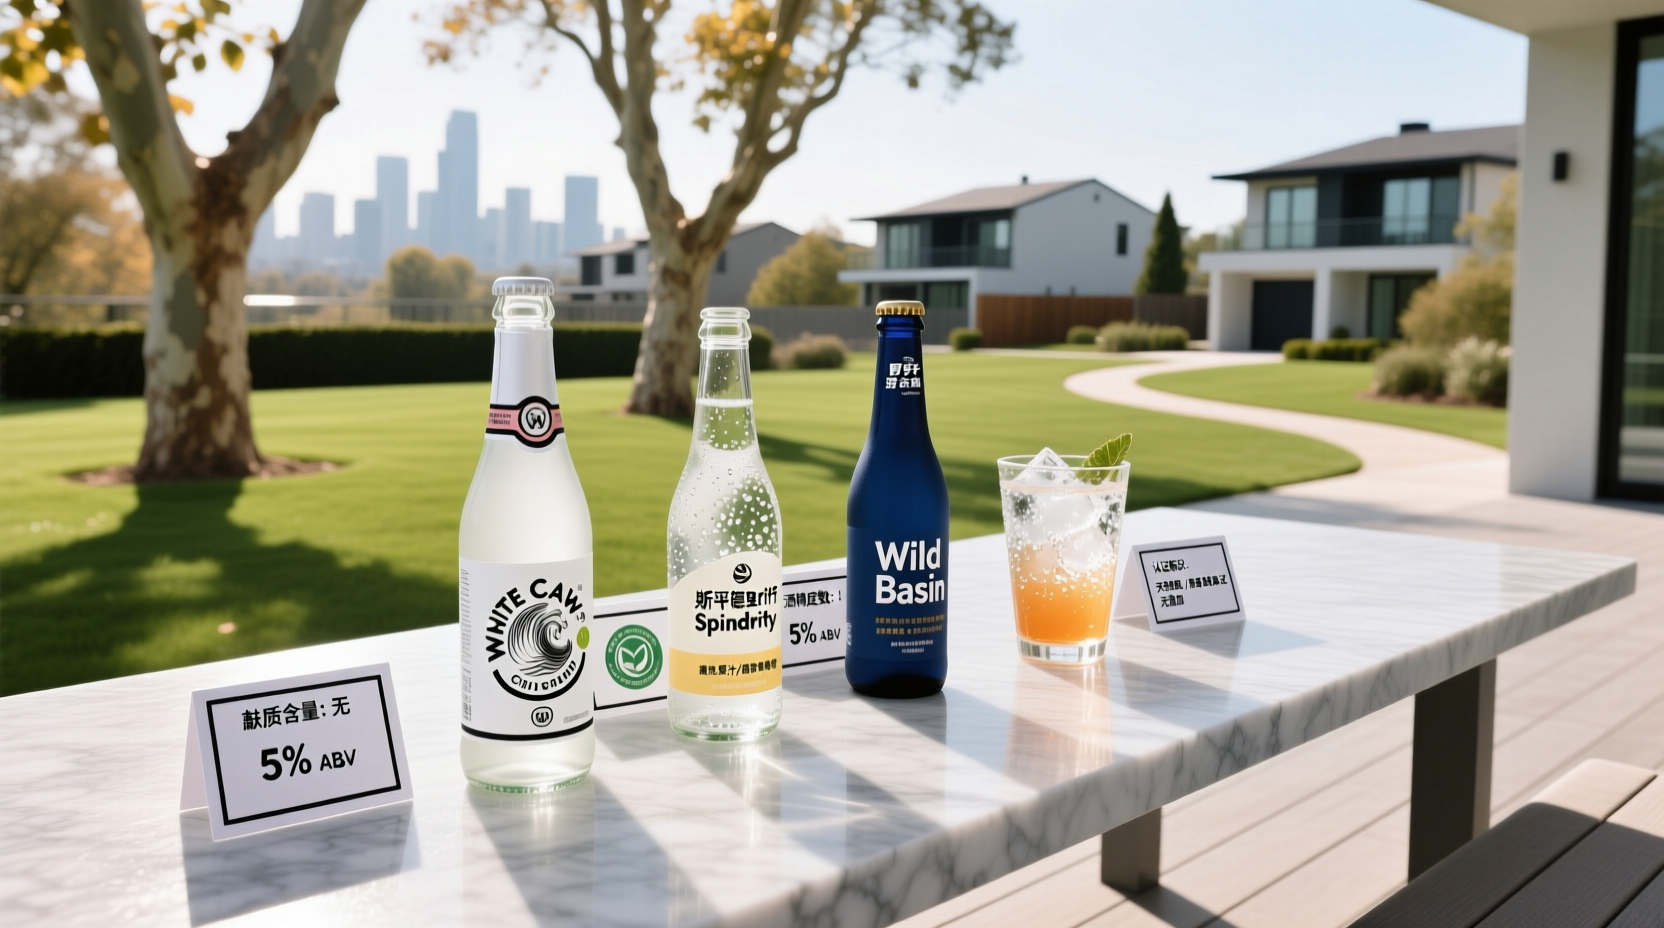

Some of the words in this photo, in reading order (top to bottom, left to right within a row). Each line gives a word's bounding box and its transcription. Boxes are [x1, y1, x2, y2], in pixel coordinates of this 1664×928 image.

[875, 538, 941, 571] Wild
[876, 573, 945, 605] Basin
[485, 587, 527, 663] WHITE
[789, 621, 817, 645] 5%
[820, 627, 841, 641] ABV
[260, 742, 312, 781] 5%
[319, 748, 357, 771] ABV
